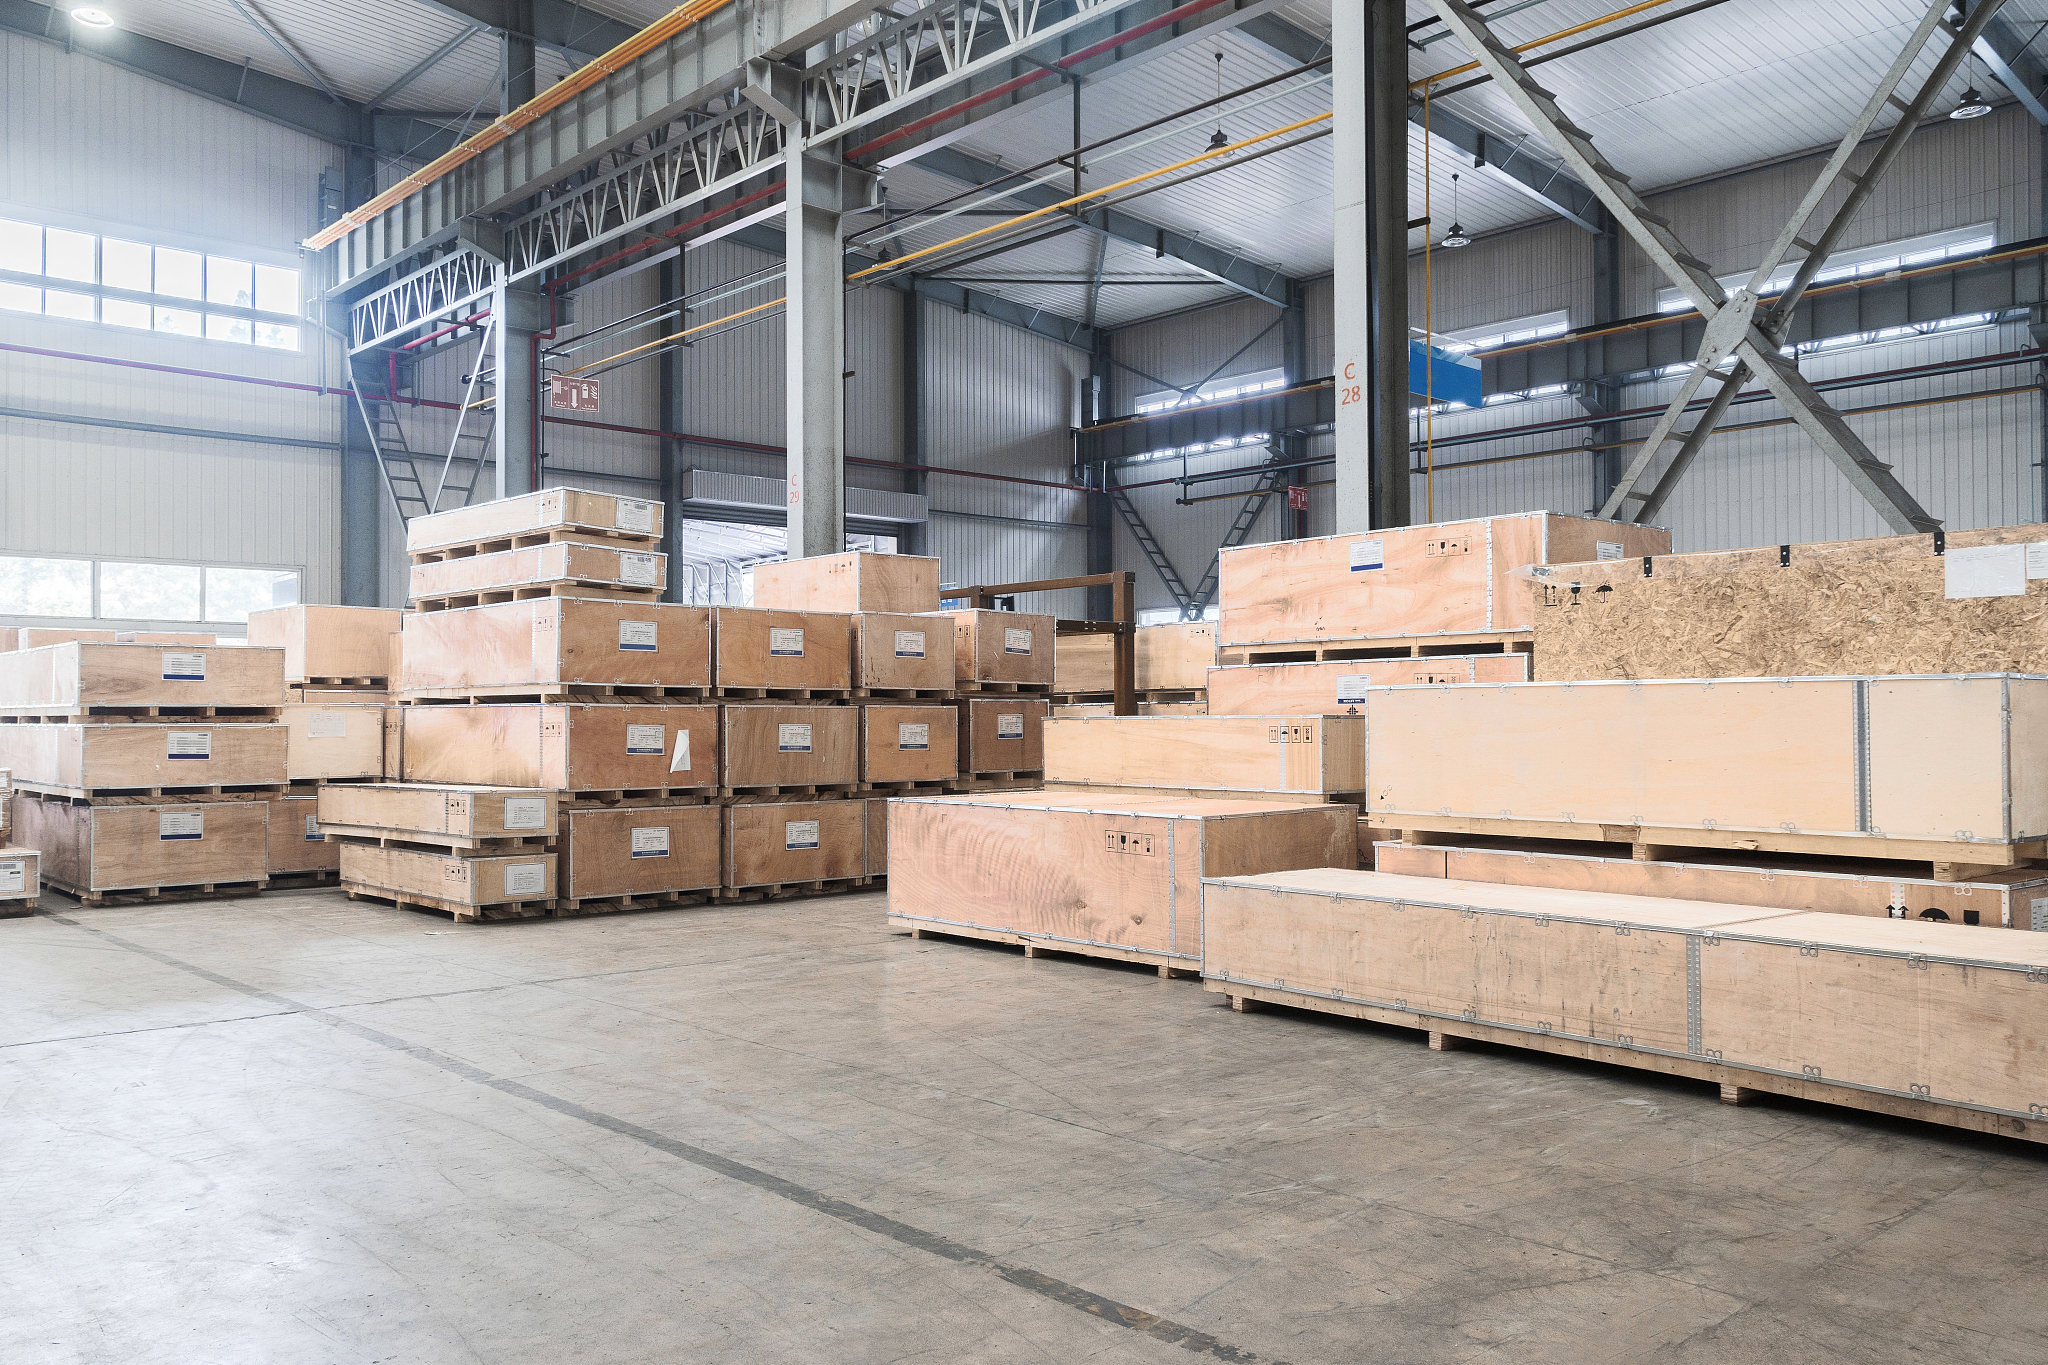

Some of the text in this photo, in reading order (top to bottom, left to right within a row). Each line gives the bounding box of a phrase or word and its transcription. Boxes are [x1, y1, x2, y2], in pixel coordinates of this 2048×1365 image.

[1344, 362, 1356, 380] C
[1341, 384, 1361, 406] 28
[791, 473, 798, 487] C
[789, 490, 800, 504] 29
